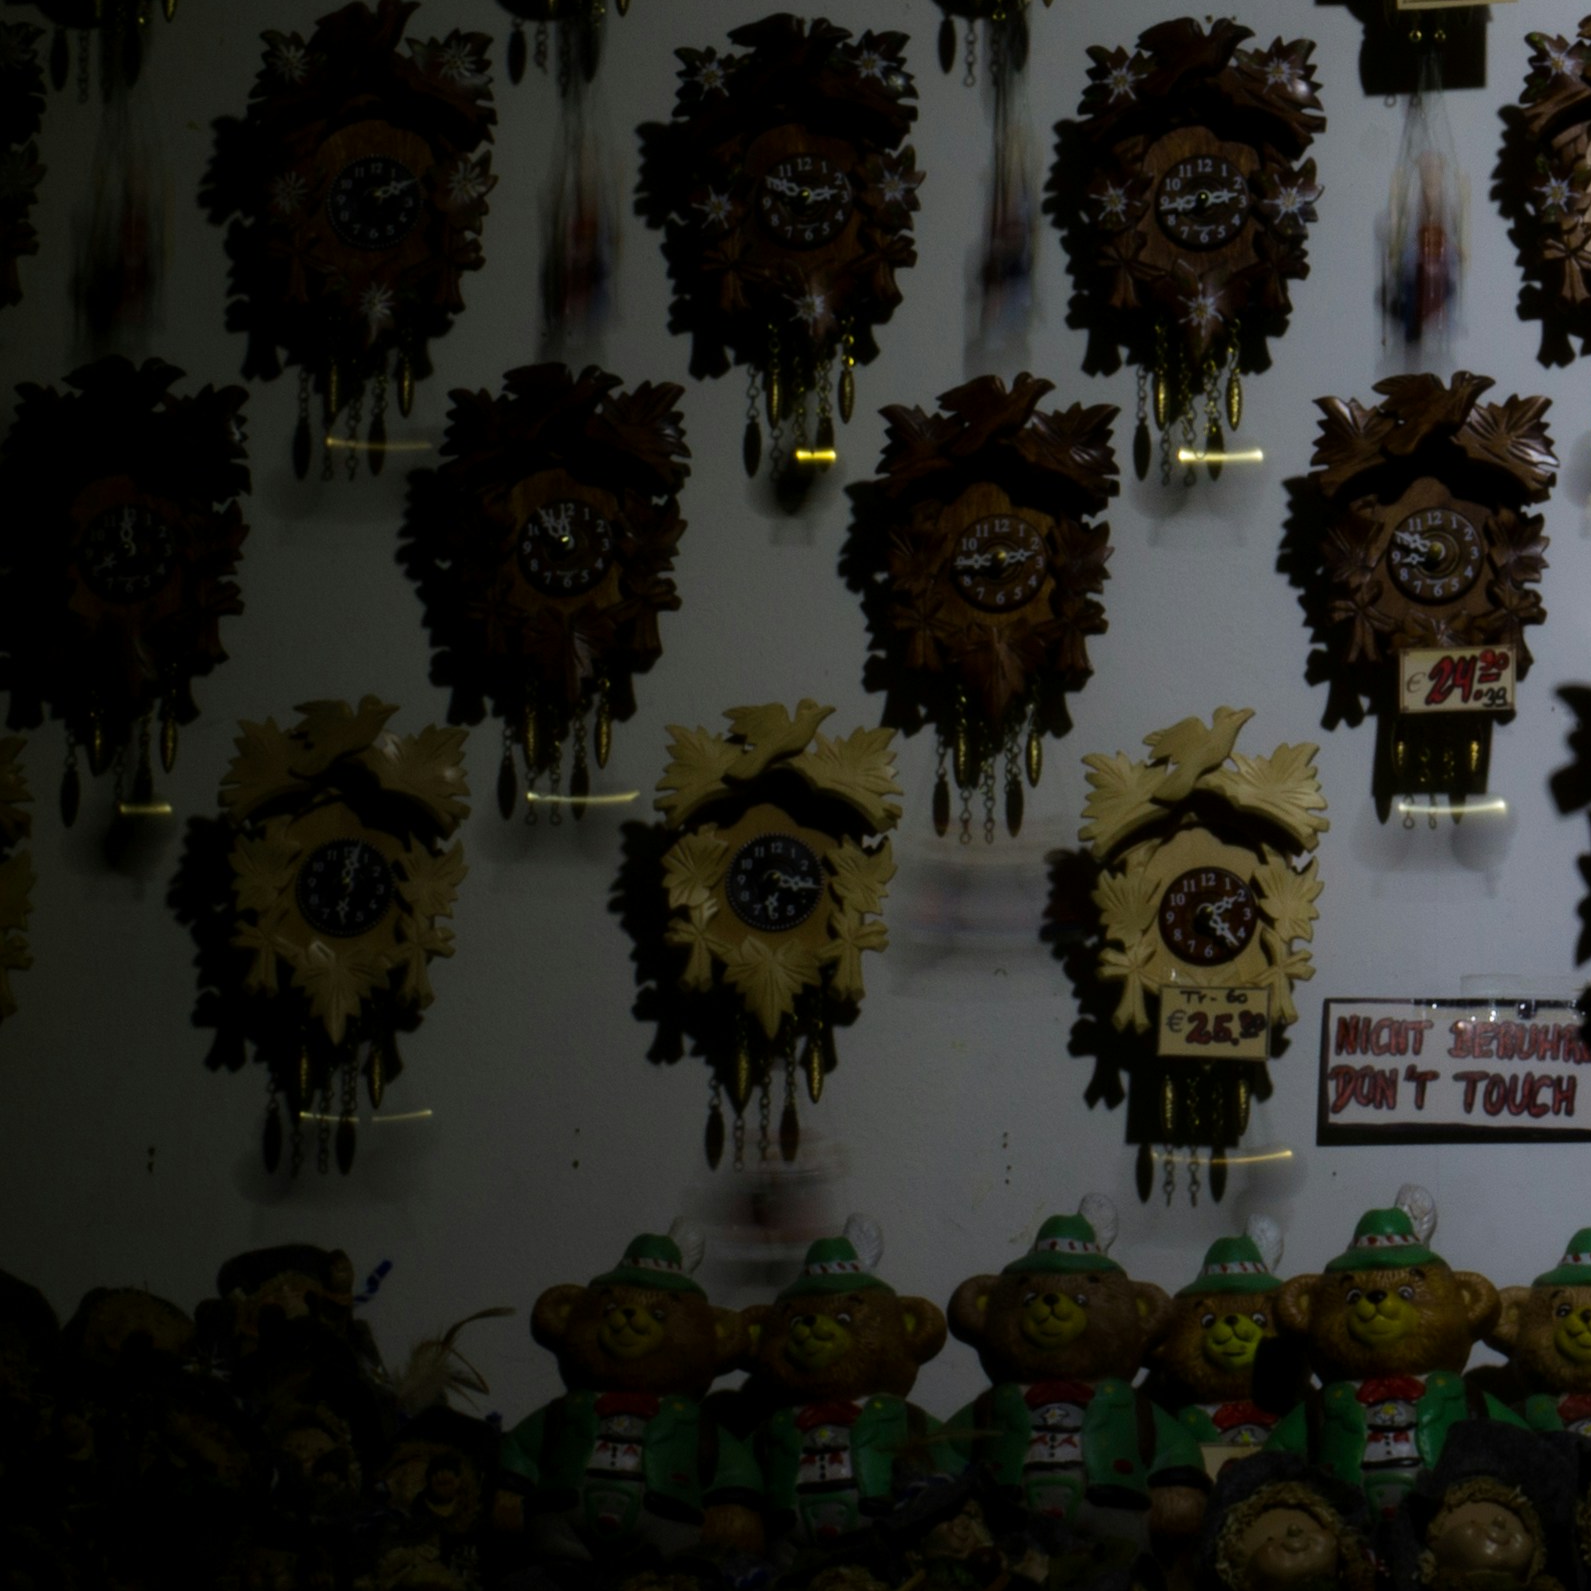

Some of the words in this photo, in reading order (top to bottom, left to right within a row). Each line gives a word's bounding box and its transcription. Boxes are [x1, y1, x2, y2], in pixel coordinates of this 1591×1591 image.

[1407, 672, 1425, 693] €
[1166, 1010, 1186, 1033] €
[1335, 1016, 1433, 1055] NICHT
[1329, 1065, 1439, 1114] DON'T
[1454, 1071, 1576, 1117] TOUCH
